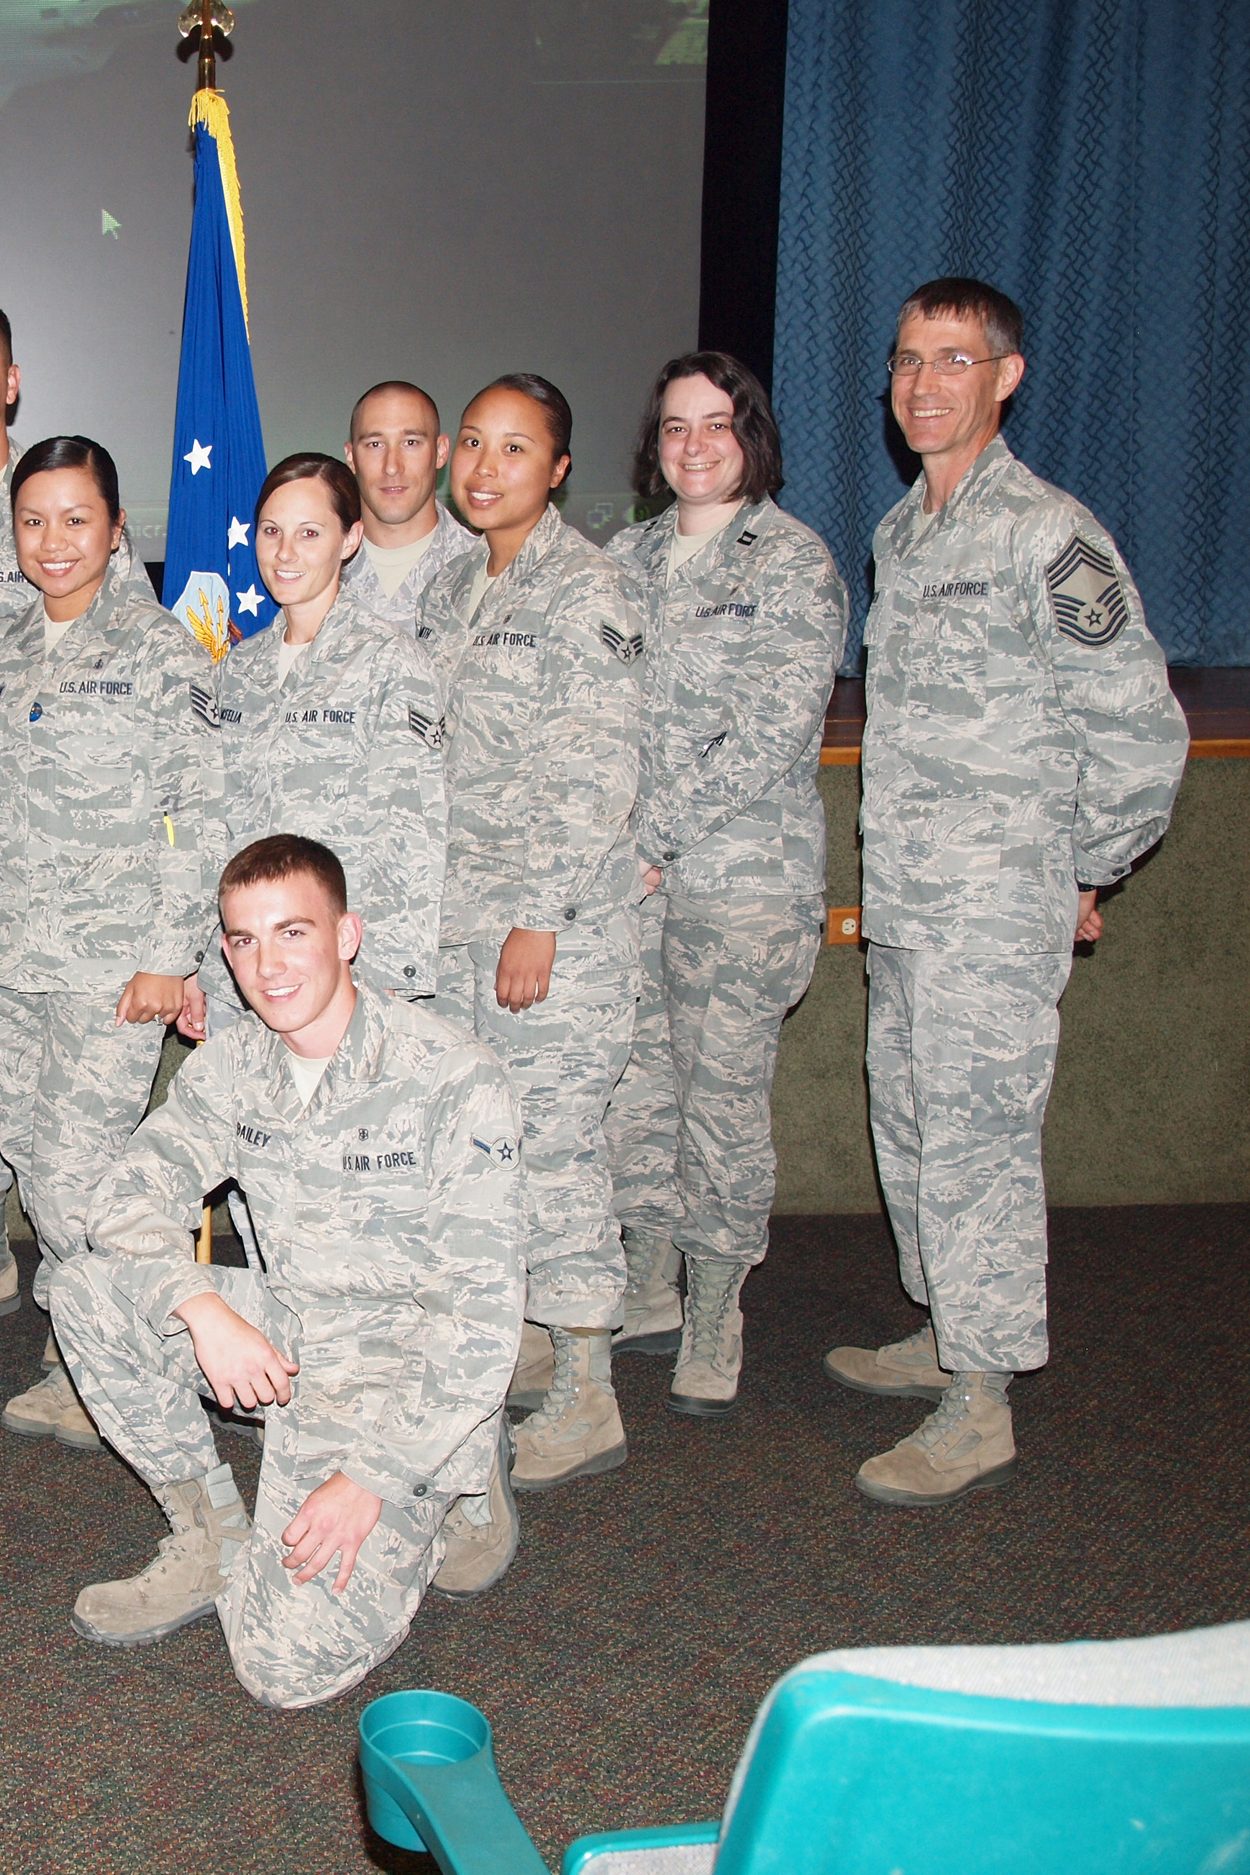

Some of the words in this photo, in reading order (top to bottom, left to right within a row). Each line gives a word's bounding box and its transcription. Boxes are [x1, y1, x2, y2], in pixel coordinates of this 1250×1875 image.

[923, 585, 937, 598] U.S.
[939, 583, 954, 596] AIR
[954, 582, 989, 596] FORCE
[728, 603, 757, 617] FORCE
[503, 633, 536, 647] FORCE
[60, 682, 77, 693] U.S.
[80, 682, 96, 694] AIR
[100, 682, 132, 695] FORCE
[285, 712, 298, 723] U.S.
[302, 711, 317, 722] AIR
[323, 710, 355, 723] FORCE
[236, 1121, 271, 1147] BAILEY
[342, 1156, 353, 1171] U.S.
[355, 1156, 370, 1171] AIR
[377, 1151, 417, 1170] FORCE
